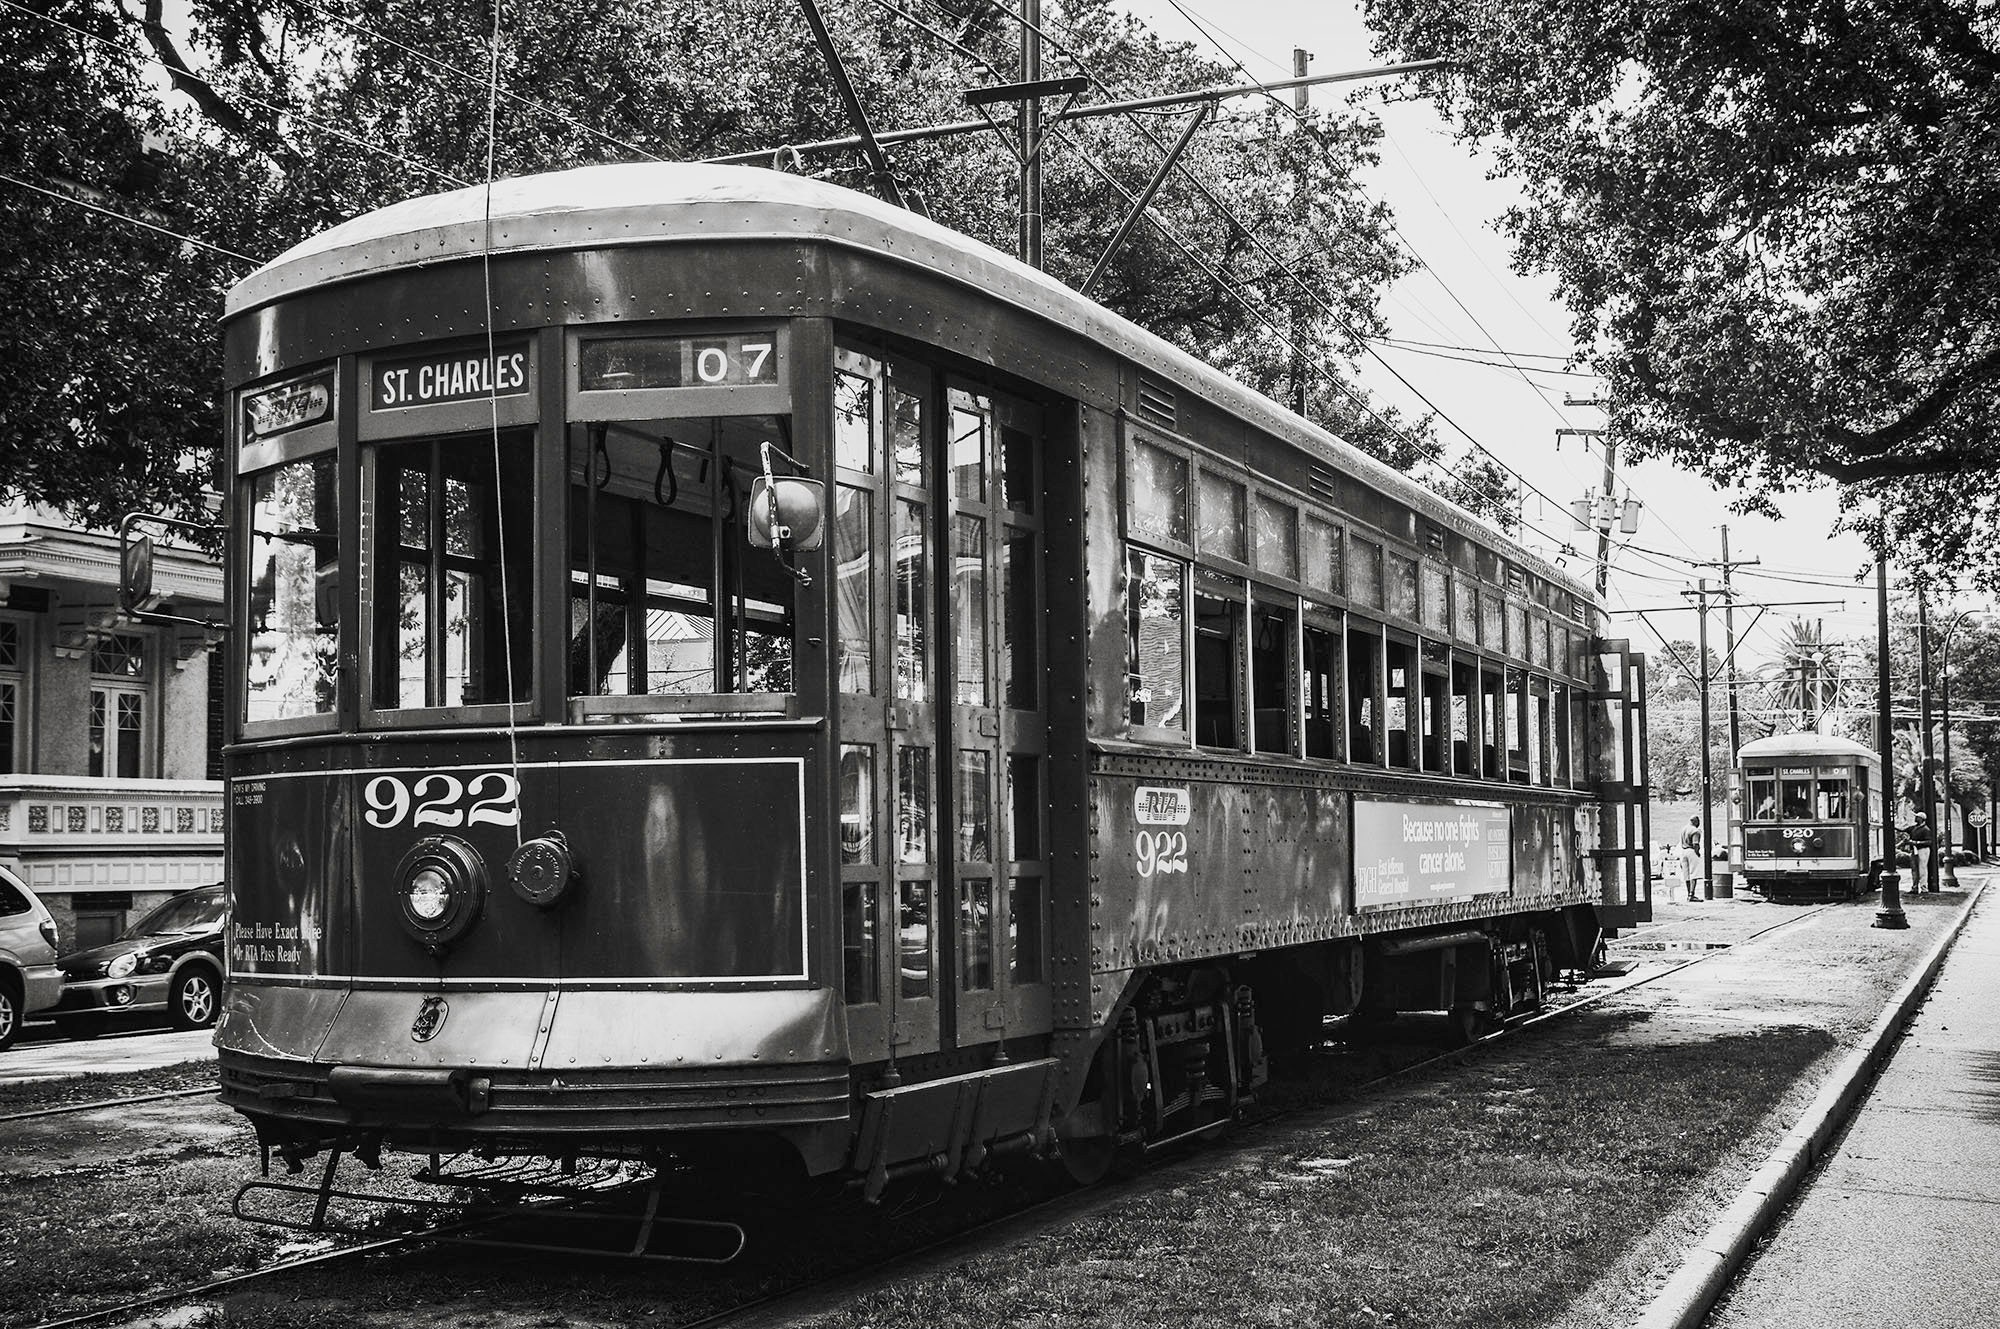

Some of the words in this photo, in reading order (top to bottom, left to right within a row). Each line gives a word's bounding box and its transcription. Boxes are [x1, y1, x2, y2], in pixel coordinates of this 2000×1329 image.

[697, 343, 772, 383] 07
[382, 369, 413, 405] ST.
[418, 353, 524, 399] CHARLES
[364, 772, 522, 829] 922
[1145, 791, 1179, 821] RTA
[1402, 813, 1434, 843] Because
[1434, 821, 1445, 842] no
[1445, 821, 1459, 842] one
[1459, 813, 1480, 848] fights
[1782, 828, 1814, 839] 920
[1969, 814, 1987, 822] STOP
[1135, 830, 1188, 878] 922
[1419, 851, 1444, 875] cancer
[1444, 844, 1466, 874] alone.
[235, 922, 254, 939] Please
[255, 922, 273, 939] Have
[275, 922, 299, 939] Exact
[235, 944, 244, 961] Or
[245, 944, 259, 961] RTA
[260, 945, 276, 962] Pass
[277, 944, 302, 965] Ready
